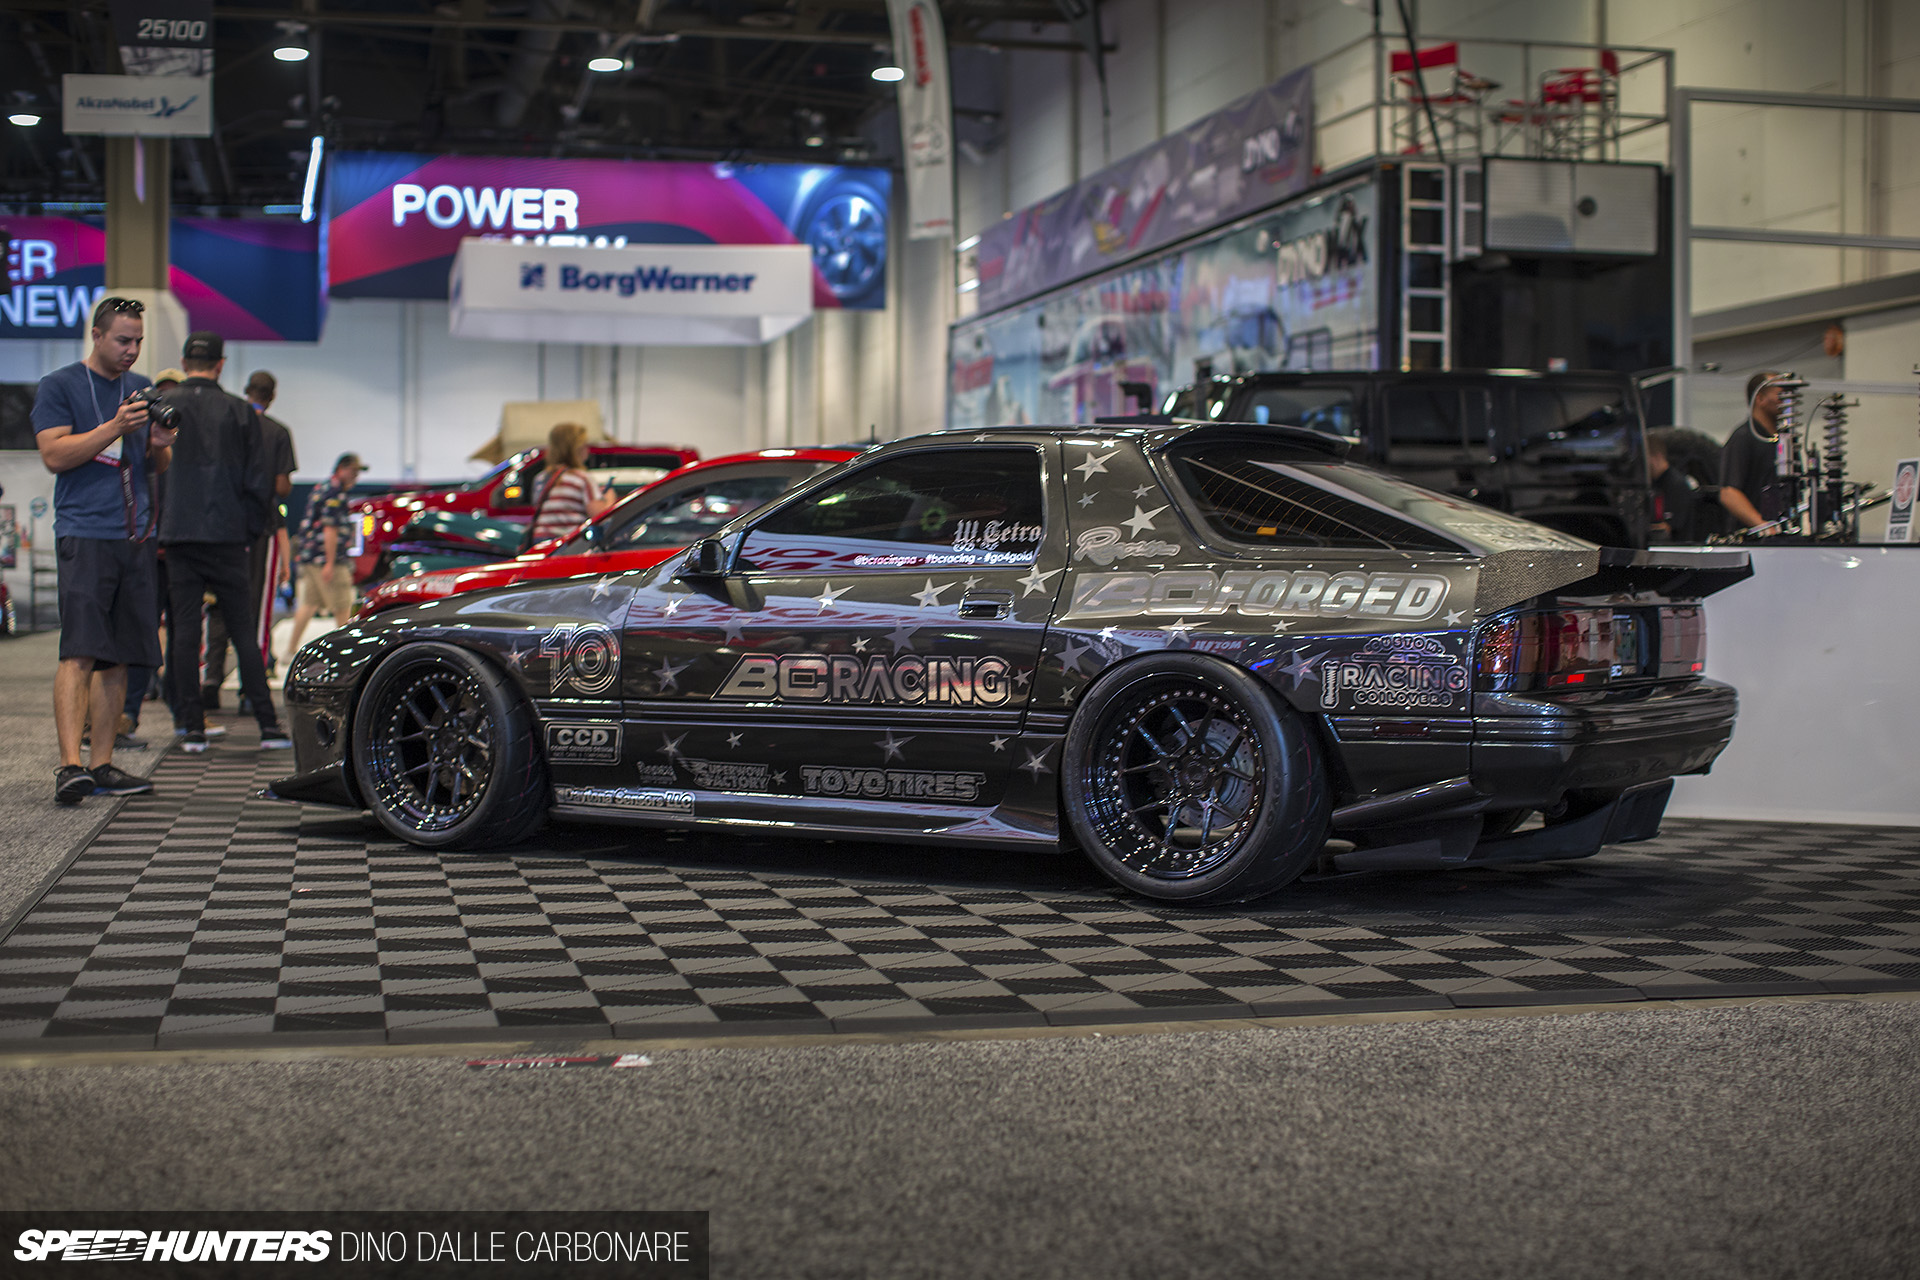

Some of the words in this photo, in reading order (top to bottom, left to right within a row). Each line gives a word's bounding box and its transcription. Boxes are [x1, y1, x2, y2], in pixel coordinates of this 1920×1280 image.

[137, 19, 206, 40] 25100
[393, 184, 579, 230] POWER
[560, 265, 757, 297] BorgWarner
[925, 554, 975, 566] #bcracing
[1370, 634, 1439, 652] CUSTOM
[539, 622, 620, 695] 10
[1342, 663, 1468, 692] RACING
[1355, 690, 1453, 707] COILOVERS
[557, 728, 609, 746] CCD
[566, 787, 612, 804] Daytona
[614, 789, 664, 807] Sensors
[665, 792, 693, 808] LLC
